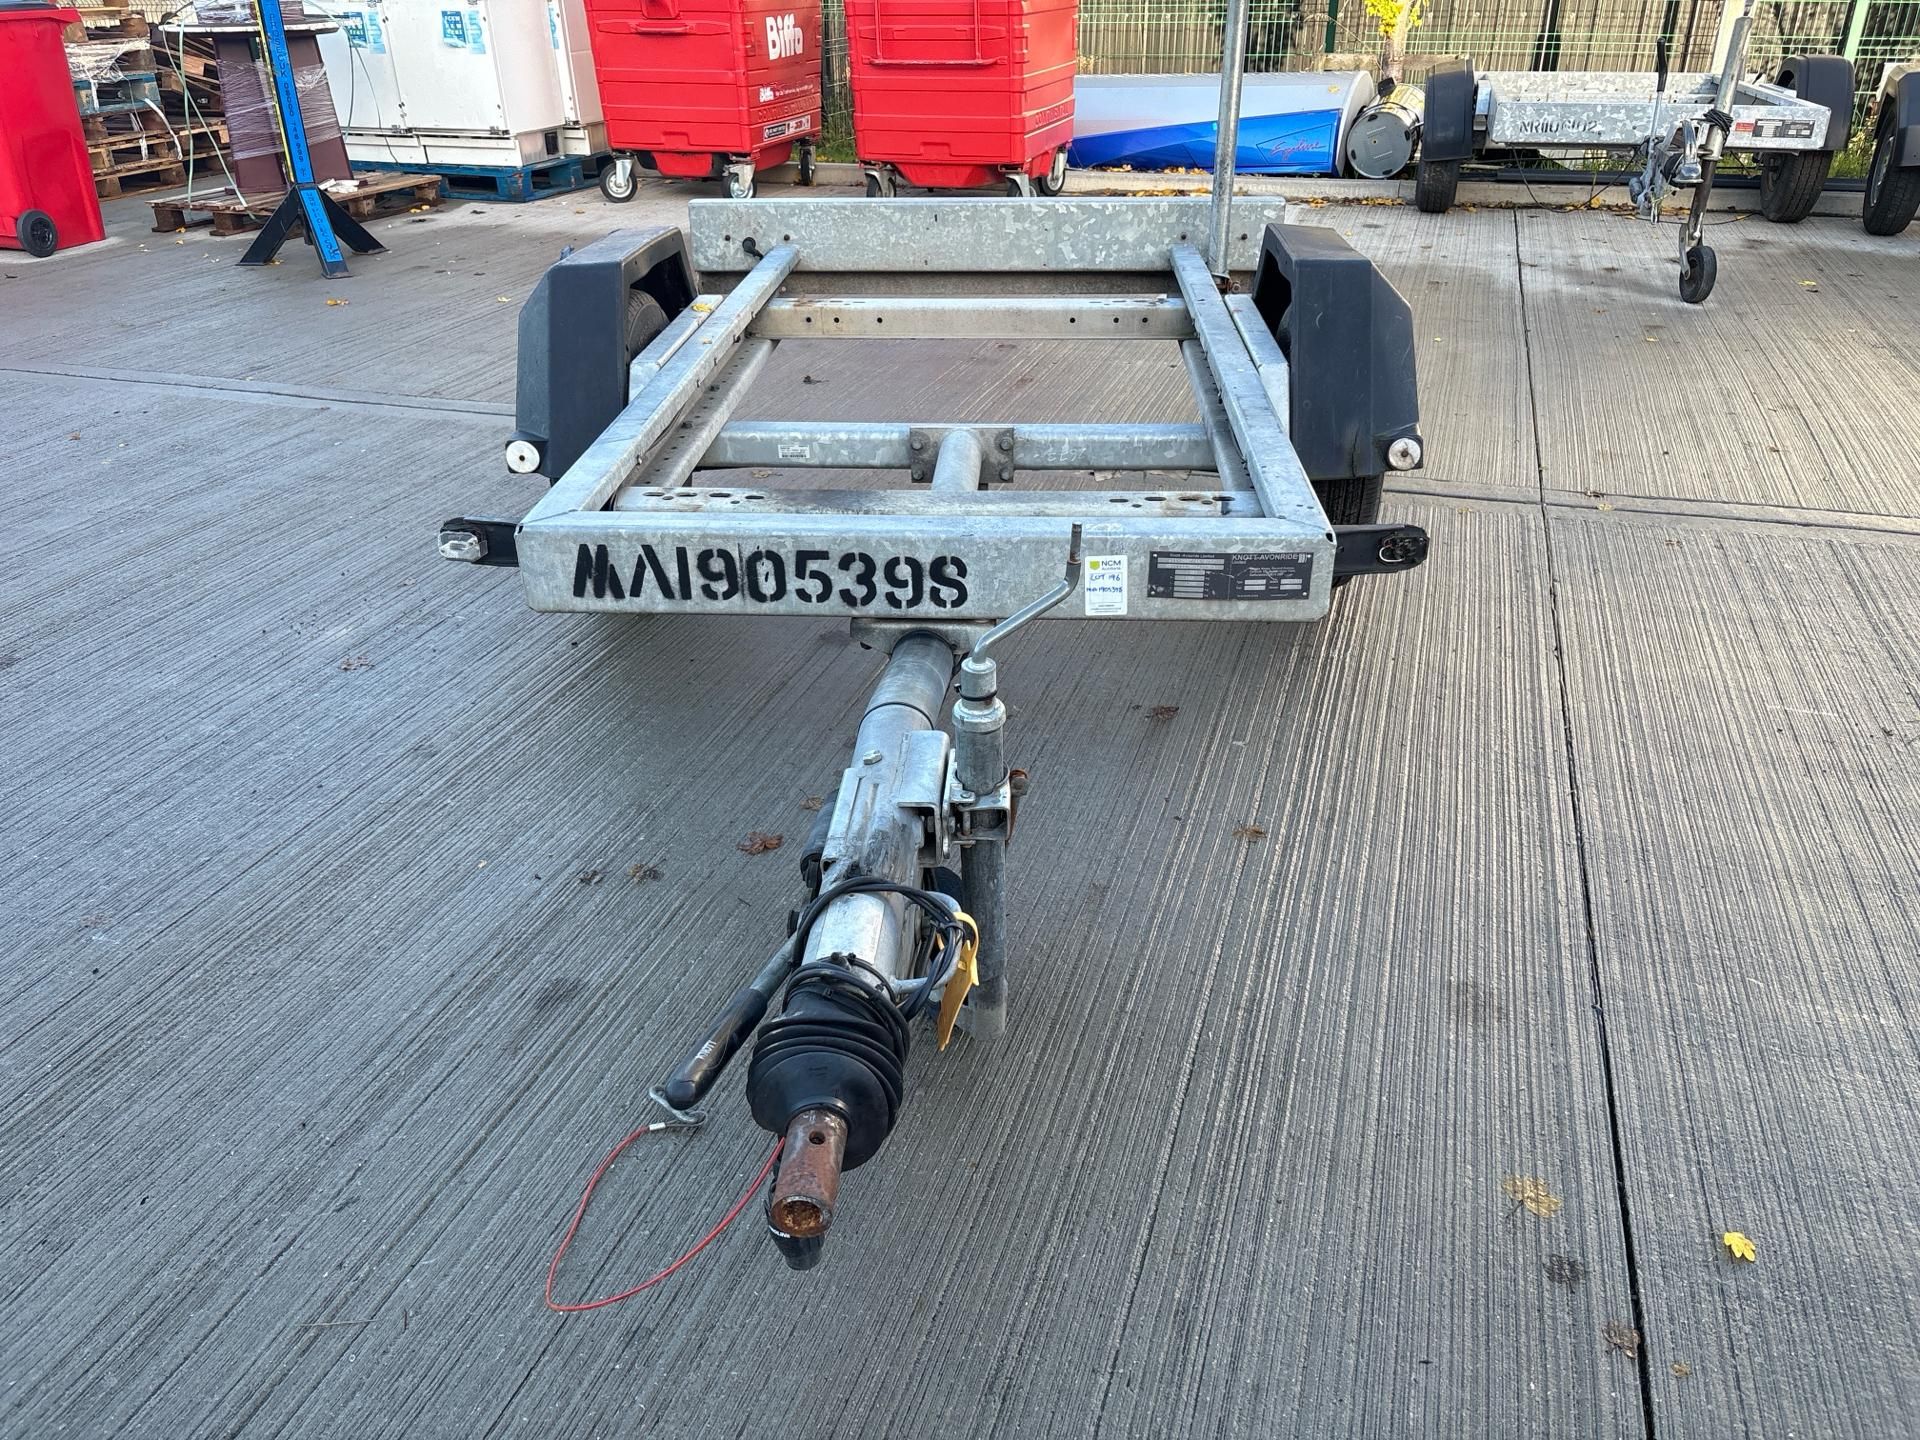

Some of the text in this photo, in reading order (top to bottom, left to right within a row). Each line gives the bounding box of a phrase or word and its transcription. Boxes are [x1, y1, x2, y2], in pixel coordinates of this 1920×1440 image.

[765, 12, 804, 61] Biffa
[759, 86, 775, 103] Biffa
[1232, 553, 1298, 561] KNOTT-AVONRIDE
